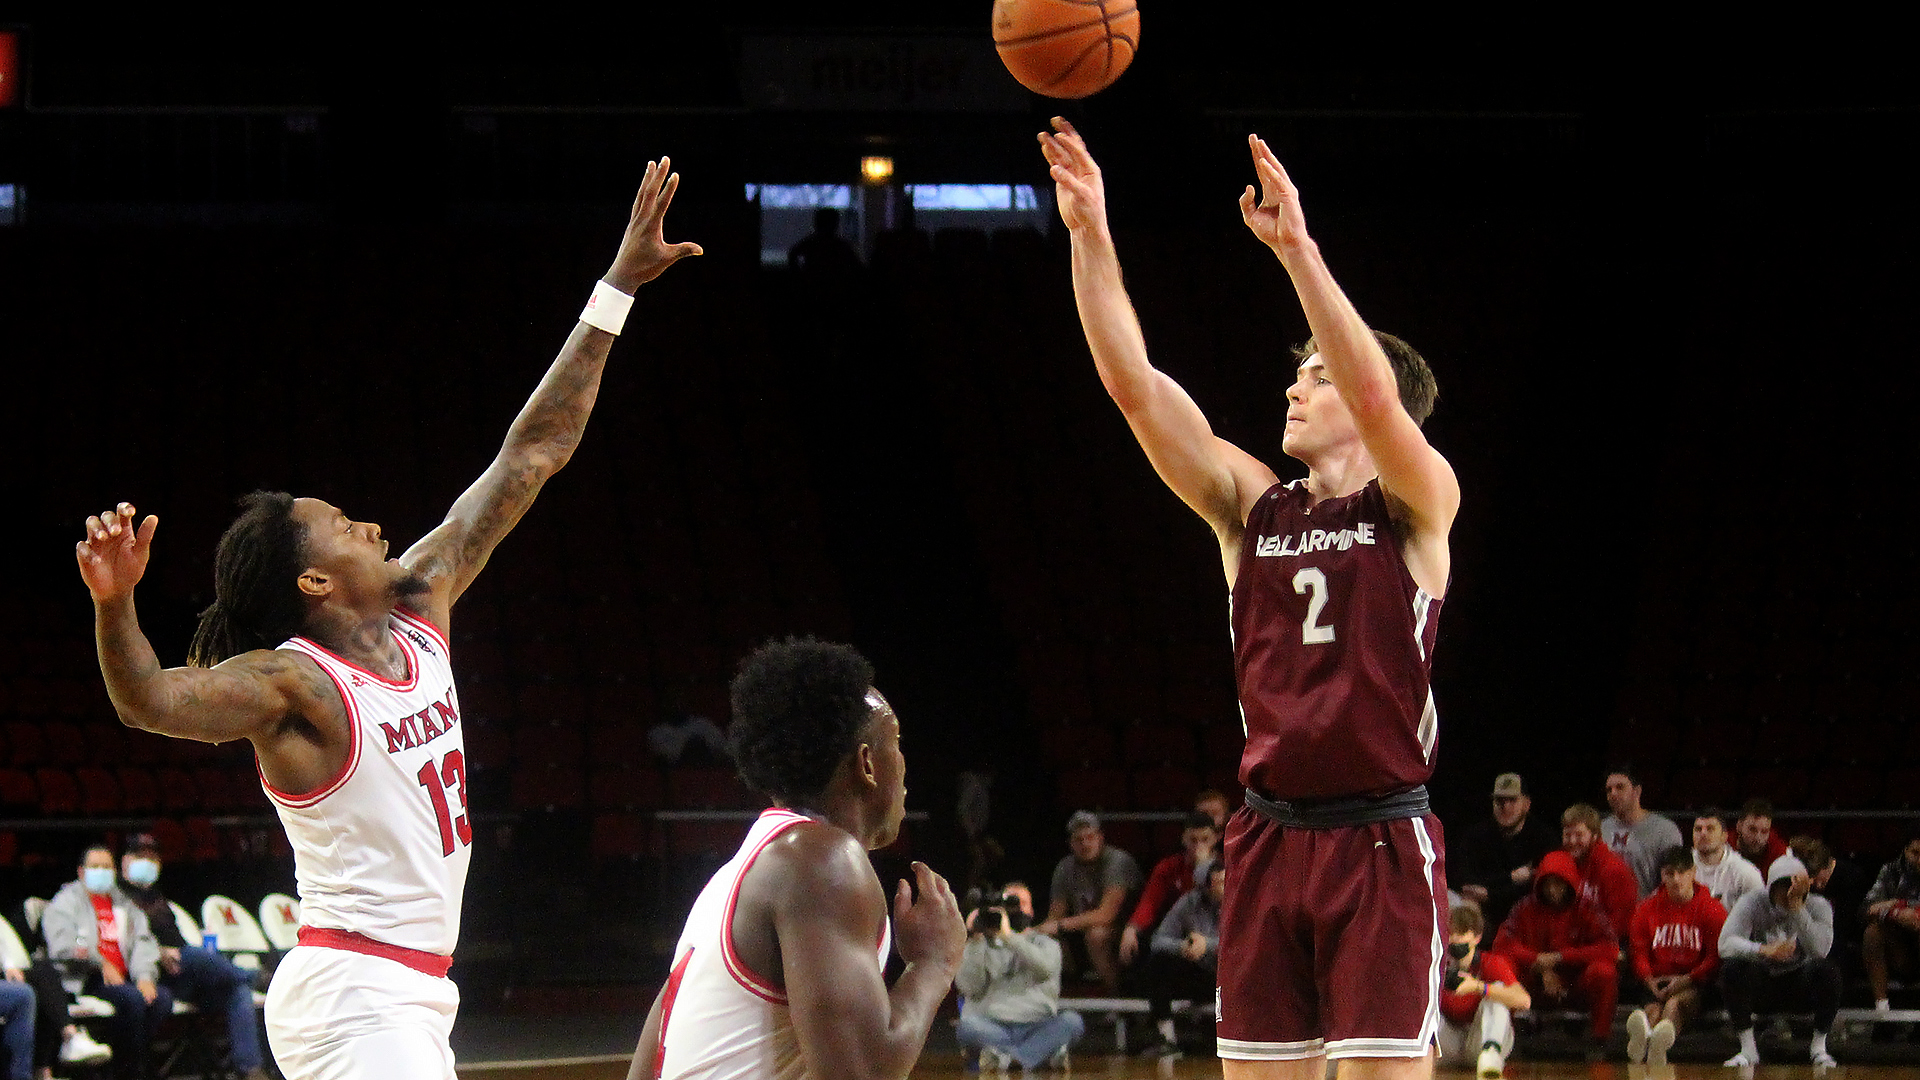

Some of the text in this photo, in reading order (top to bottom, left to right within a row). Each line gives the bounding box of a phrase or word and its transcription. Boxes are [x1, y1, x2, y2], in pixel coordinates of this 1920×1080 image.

[1292, 566, 1336, 645] 2
[417, 748, 473, 858] 13
[1652, 923, 1701, 951] MIAMI
